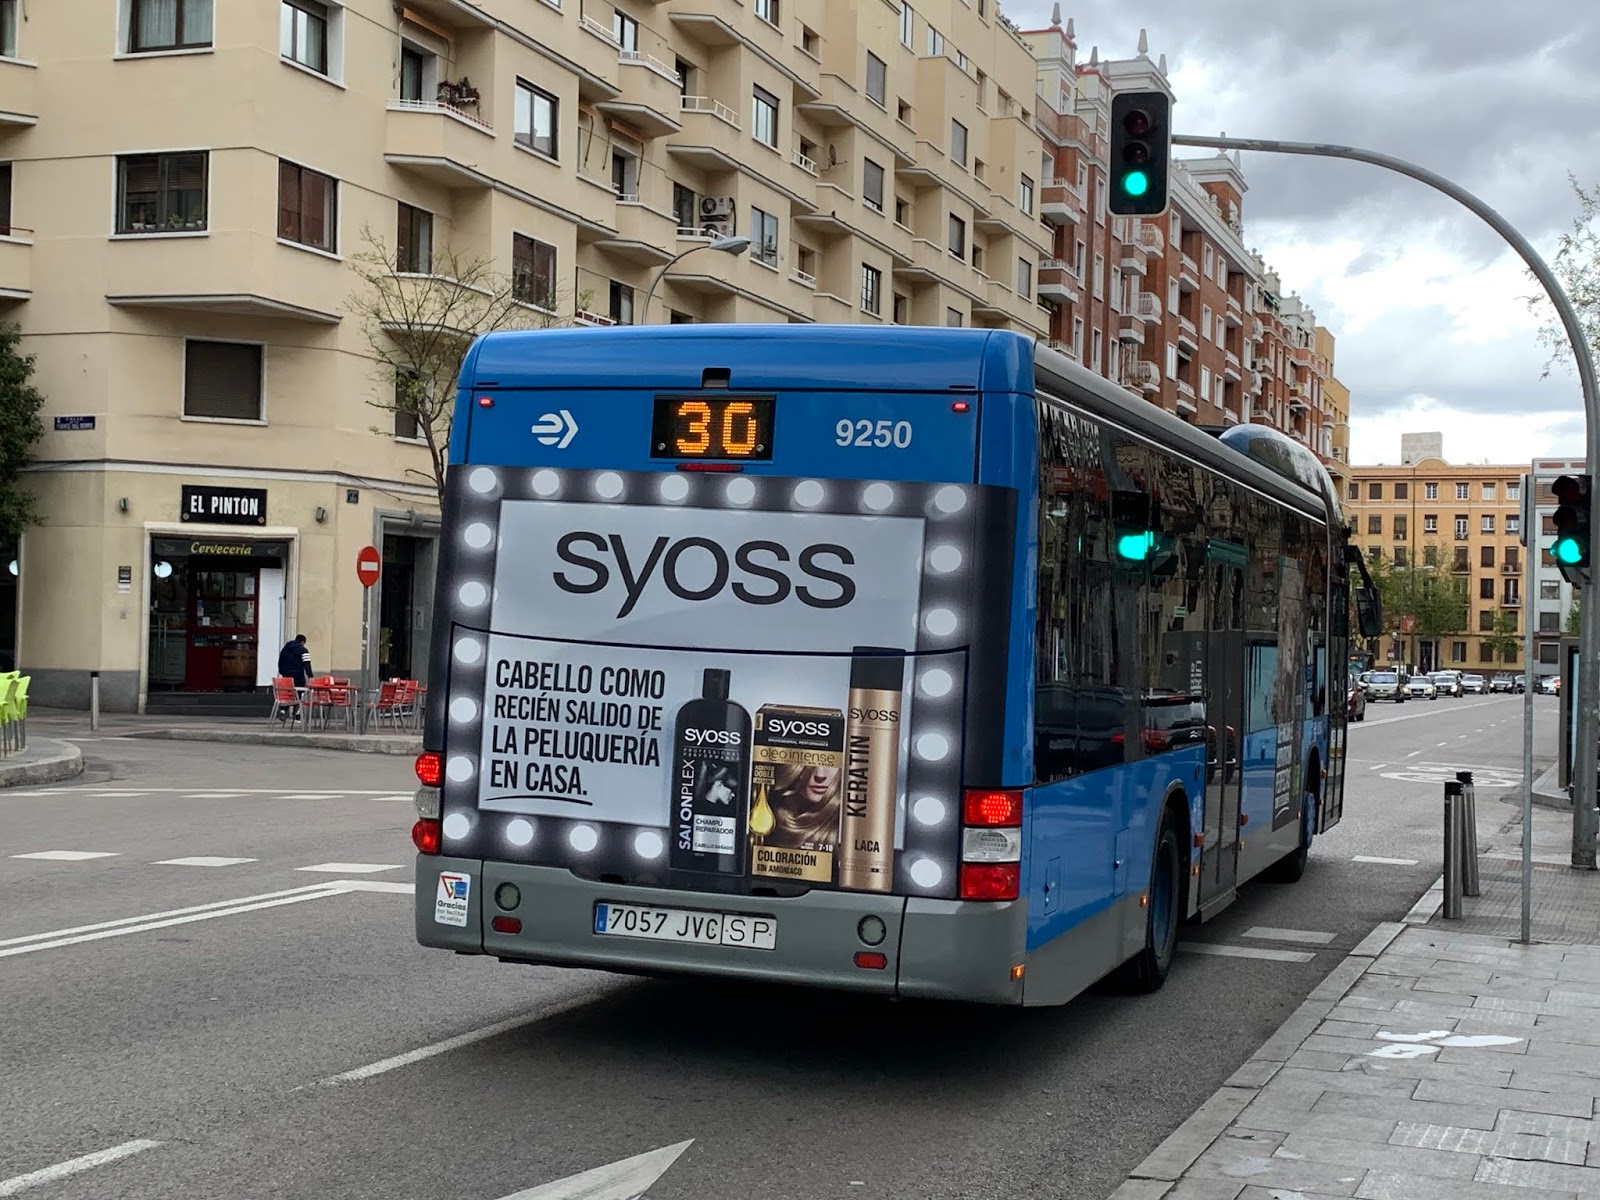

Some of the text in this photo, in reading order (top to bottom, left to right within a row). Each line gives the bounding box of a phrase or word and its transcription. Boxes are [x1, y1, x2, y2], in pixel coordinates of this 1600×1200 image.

[676, 401, 757, 454] 30
[835, 418, 913, 448] 9250
[190, 495, 259, 516] EL PINTÓN
[553, 531, 856, 619] syoss
[496, 659, 665, 699] CABELLO COMO
[494, 692, 663, 731] RECIÉN SALIDO DE
[850, 707, 899, 723] syoss
[684, 728, 741, 745] syoss
[768, 719, 830, 737] syoss
[492, 725, 660, 766] LA PELUQUERÍA
[789, 749, 835, 763] intense
[490, 760, 588, 795] EN CASA.
[847, 735, 870, 818] KERATIN
[695, 818, 723, 826] CHAMPÚ
[695, 826, 734, 835] REPARADOR
[854, 839, 880, 853] LACA
[756, 863, 767, 872] SIN
[757, 850, 817, 866] COLORACIÓN
[437, 900, 466, 910] Gracias
[611, 907, 669, 935] 7057
[675, 914, 718, 940] JVC
